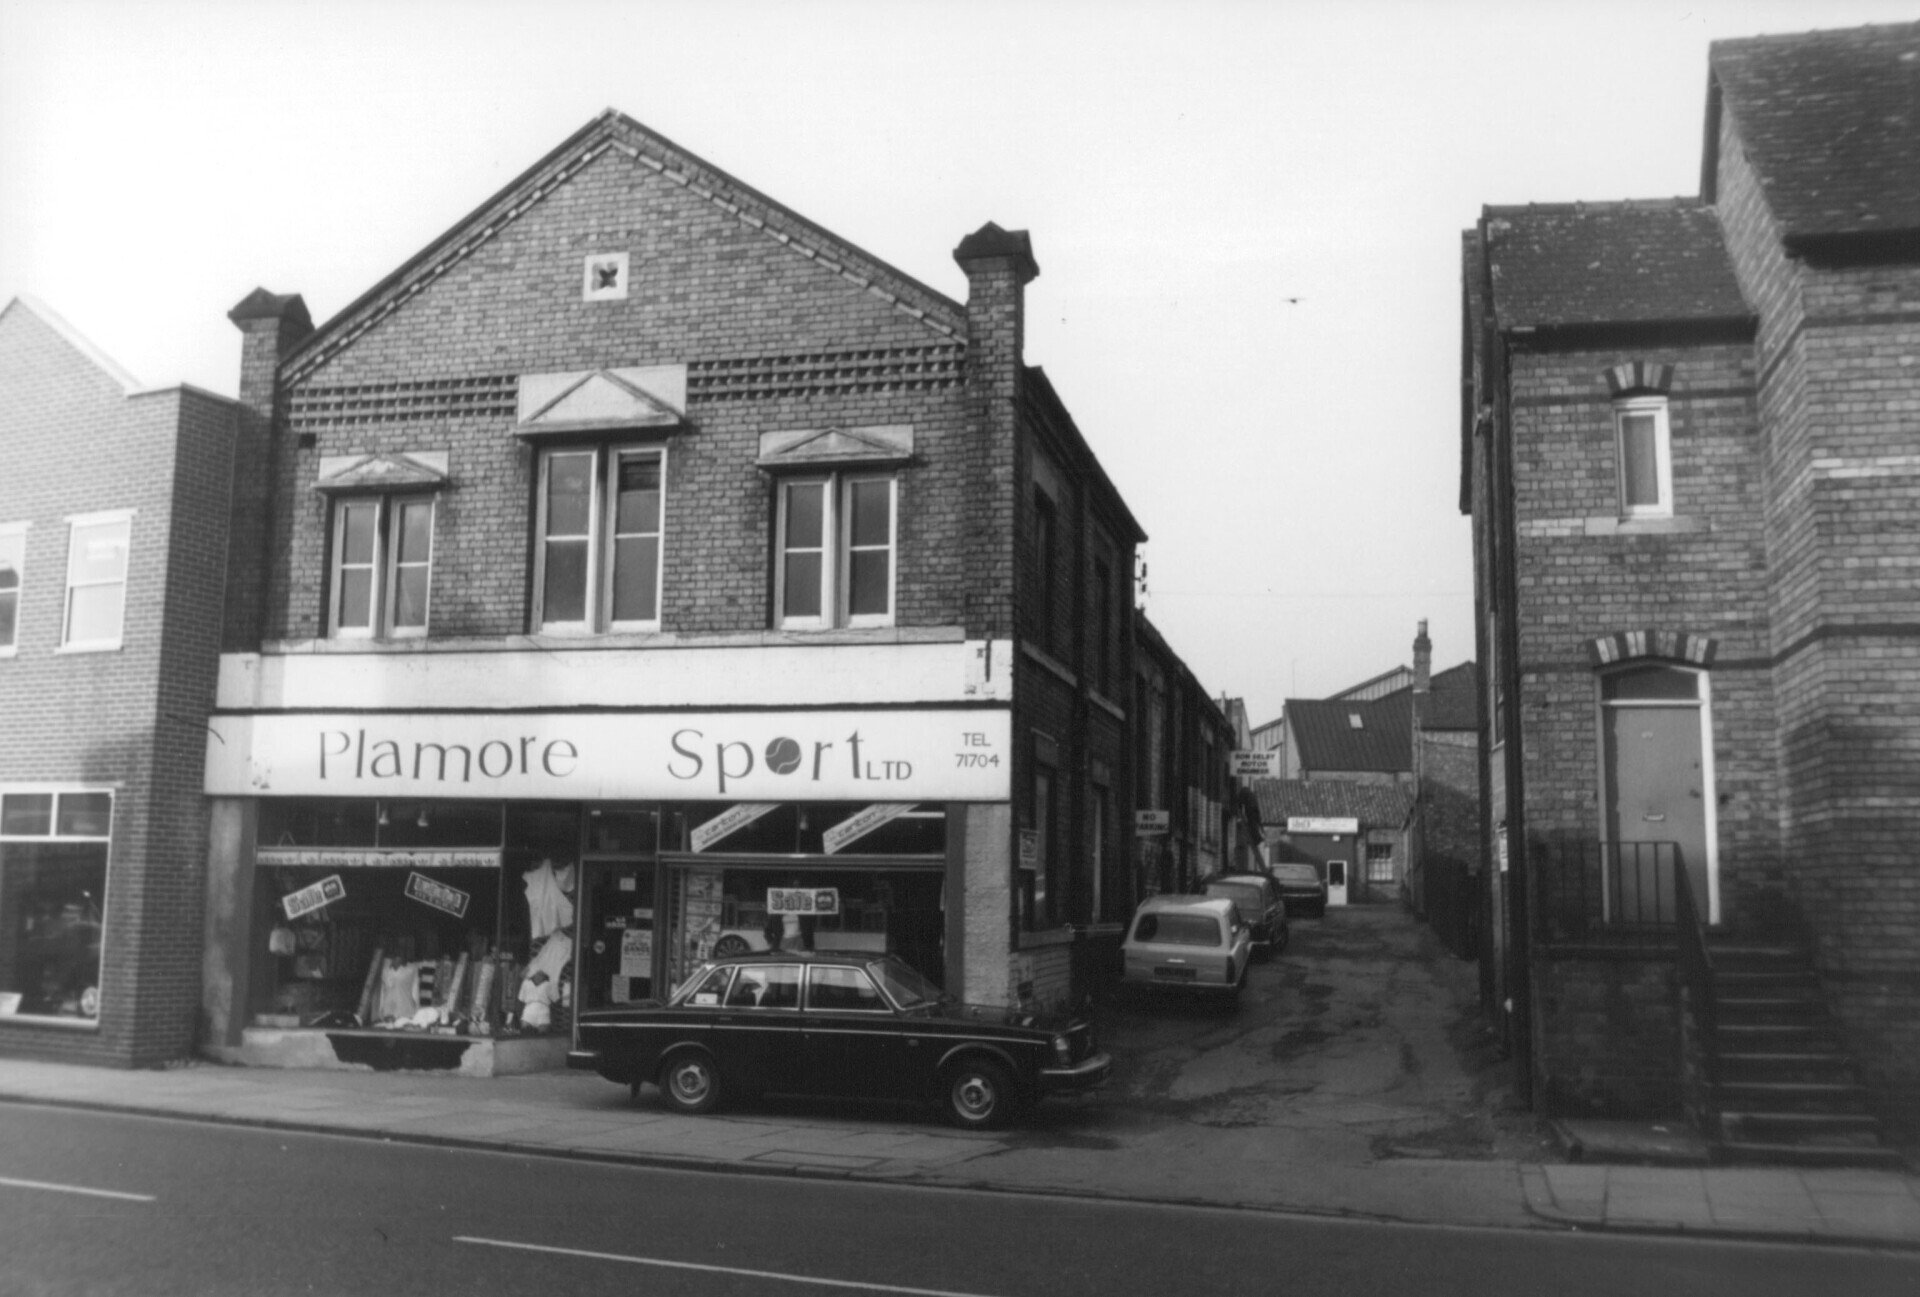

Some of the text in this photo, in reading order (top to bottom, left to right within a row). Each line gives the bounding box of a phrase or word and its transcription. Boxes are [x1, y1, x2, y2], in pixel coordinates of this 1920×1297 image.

[962, 732, 991, 747] TEL
[319, 728, 912, 794] Plamore Sport LTD
[955, 754, 1000, 768] 71704
[1142, 813, 1156, 821] NO
